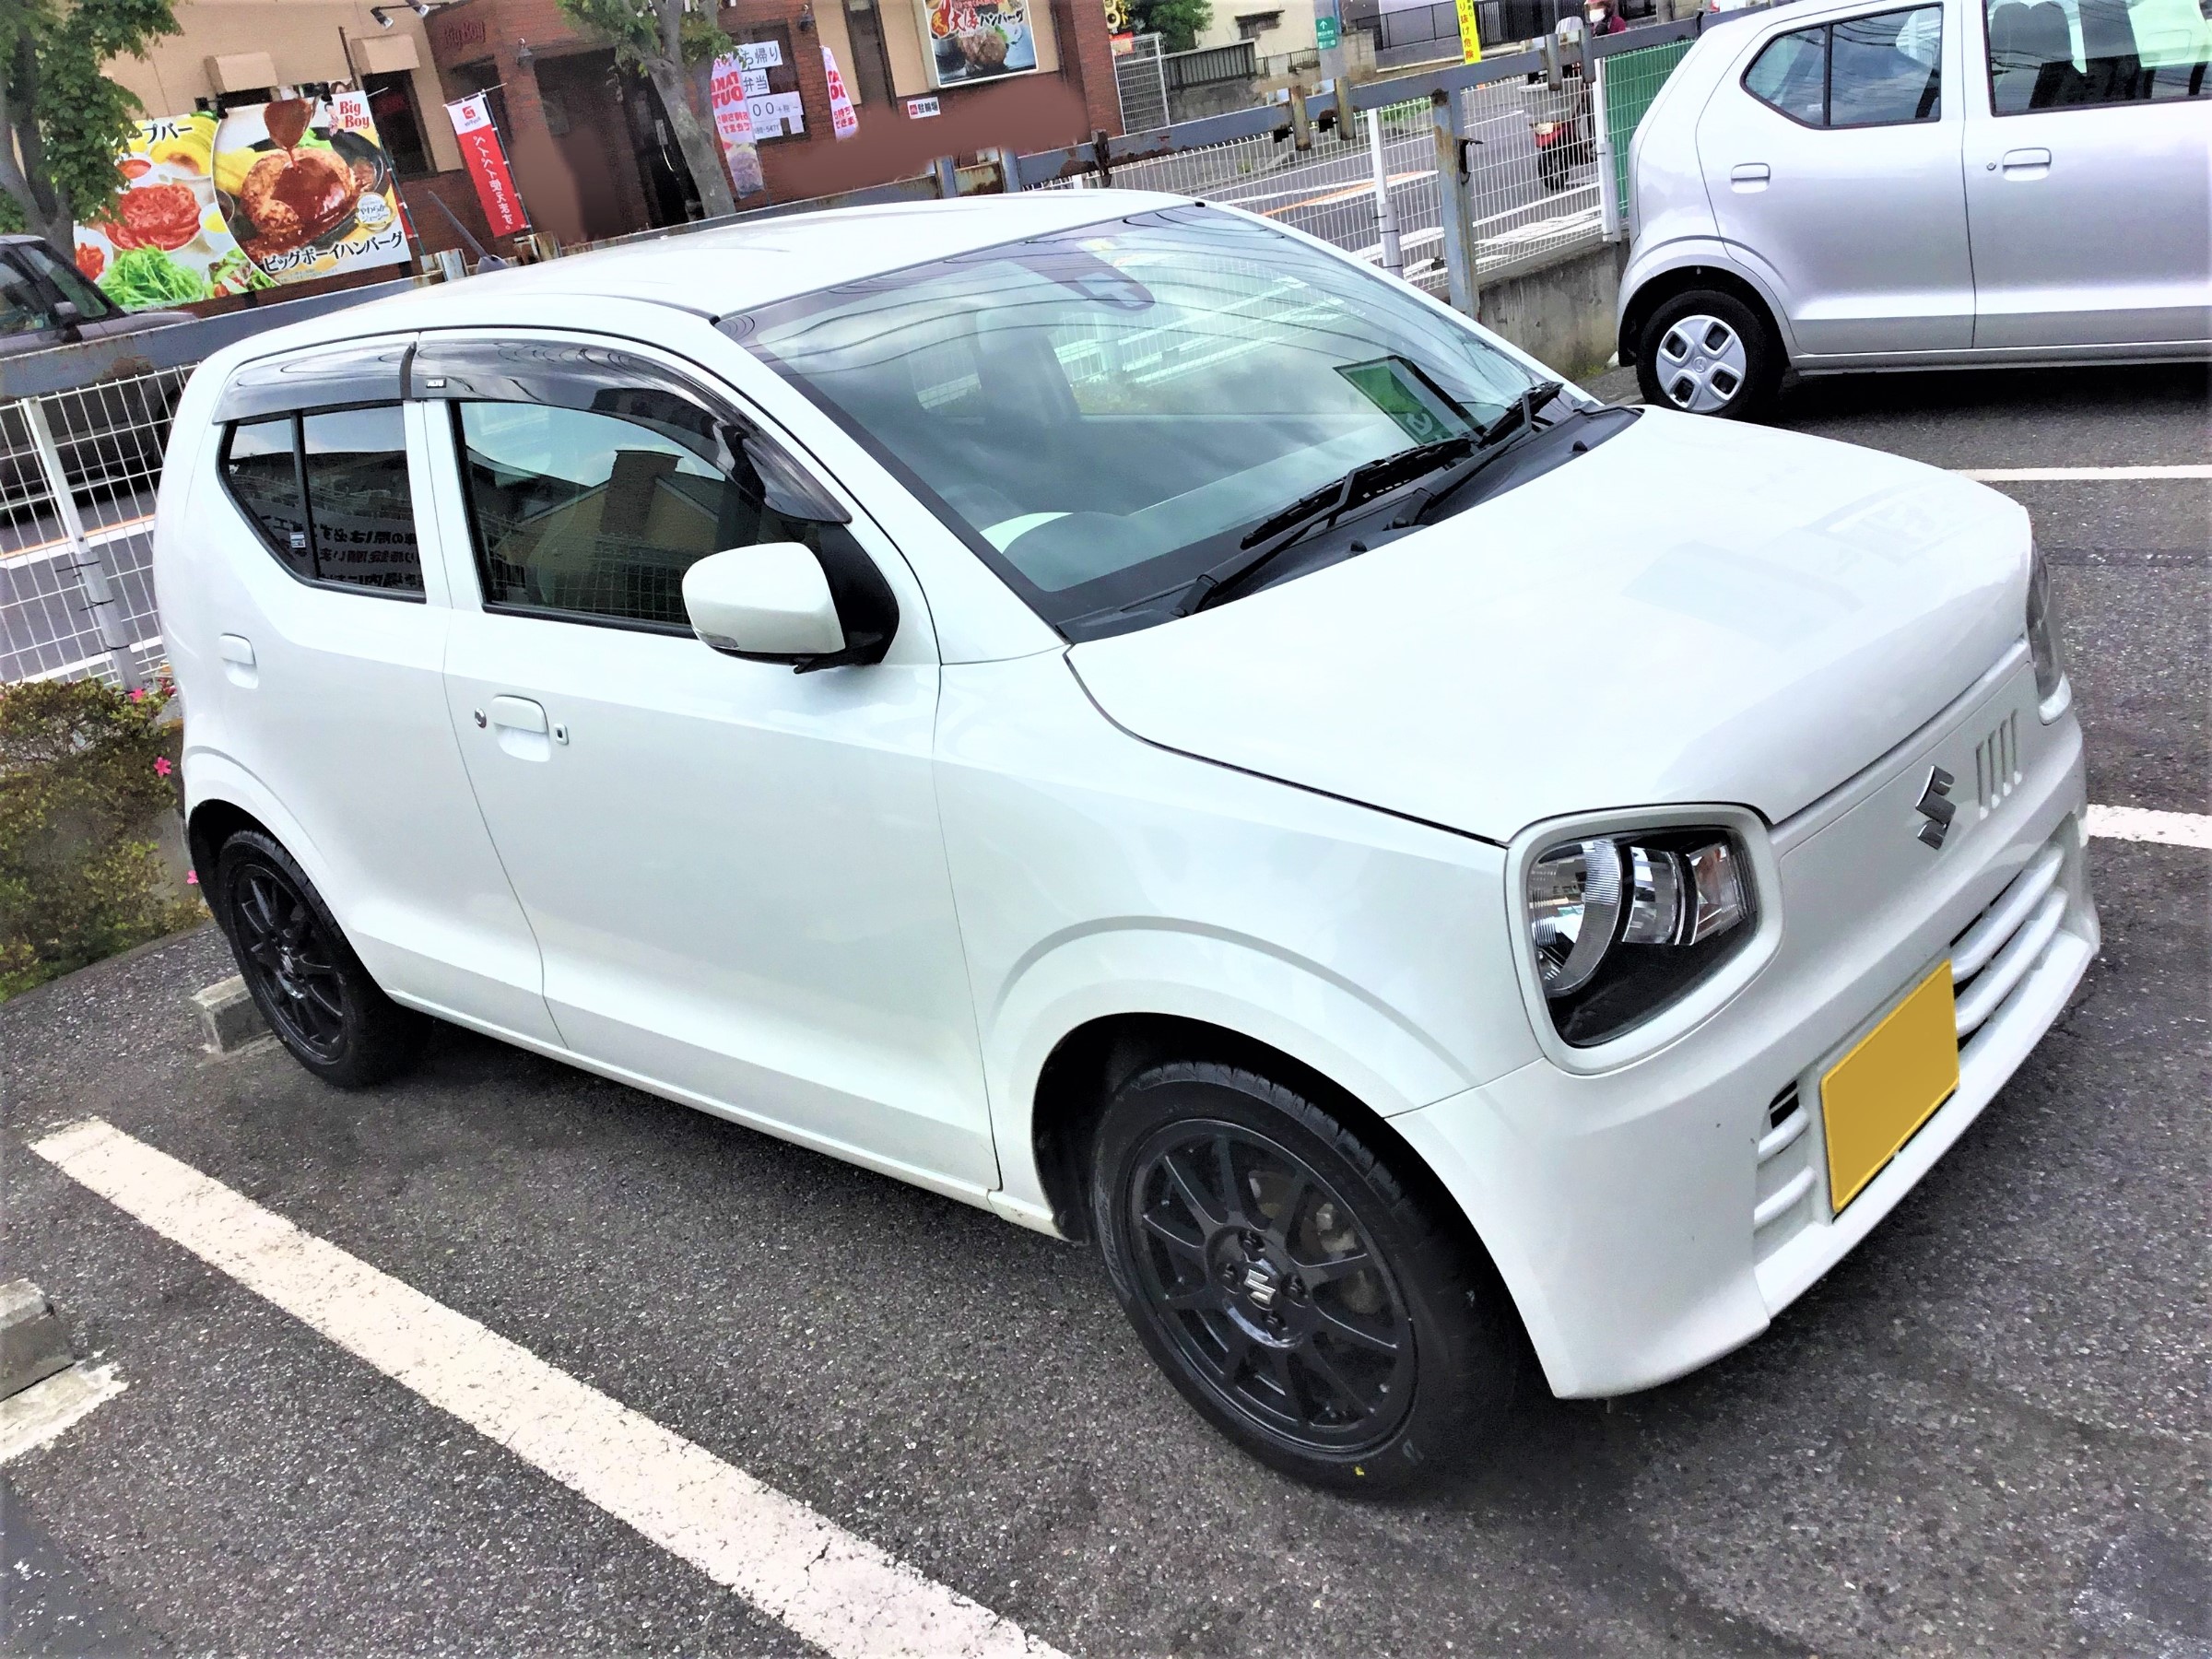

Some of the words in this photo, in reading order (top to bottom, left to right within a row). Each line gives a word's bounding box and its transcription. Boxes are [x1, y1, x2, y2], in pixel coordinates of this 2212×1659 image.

[743, 76, 768, 93] 弁当
[339, 100, 361, 116] Big
[345, 115, 370, 129] Boy
[264, 231, 403, 272] ビッグボーイハンバーグ
